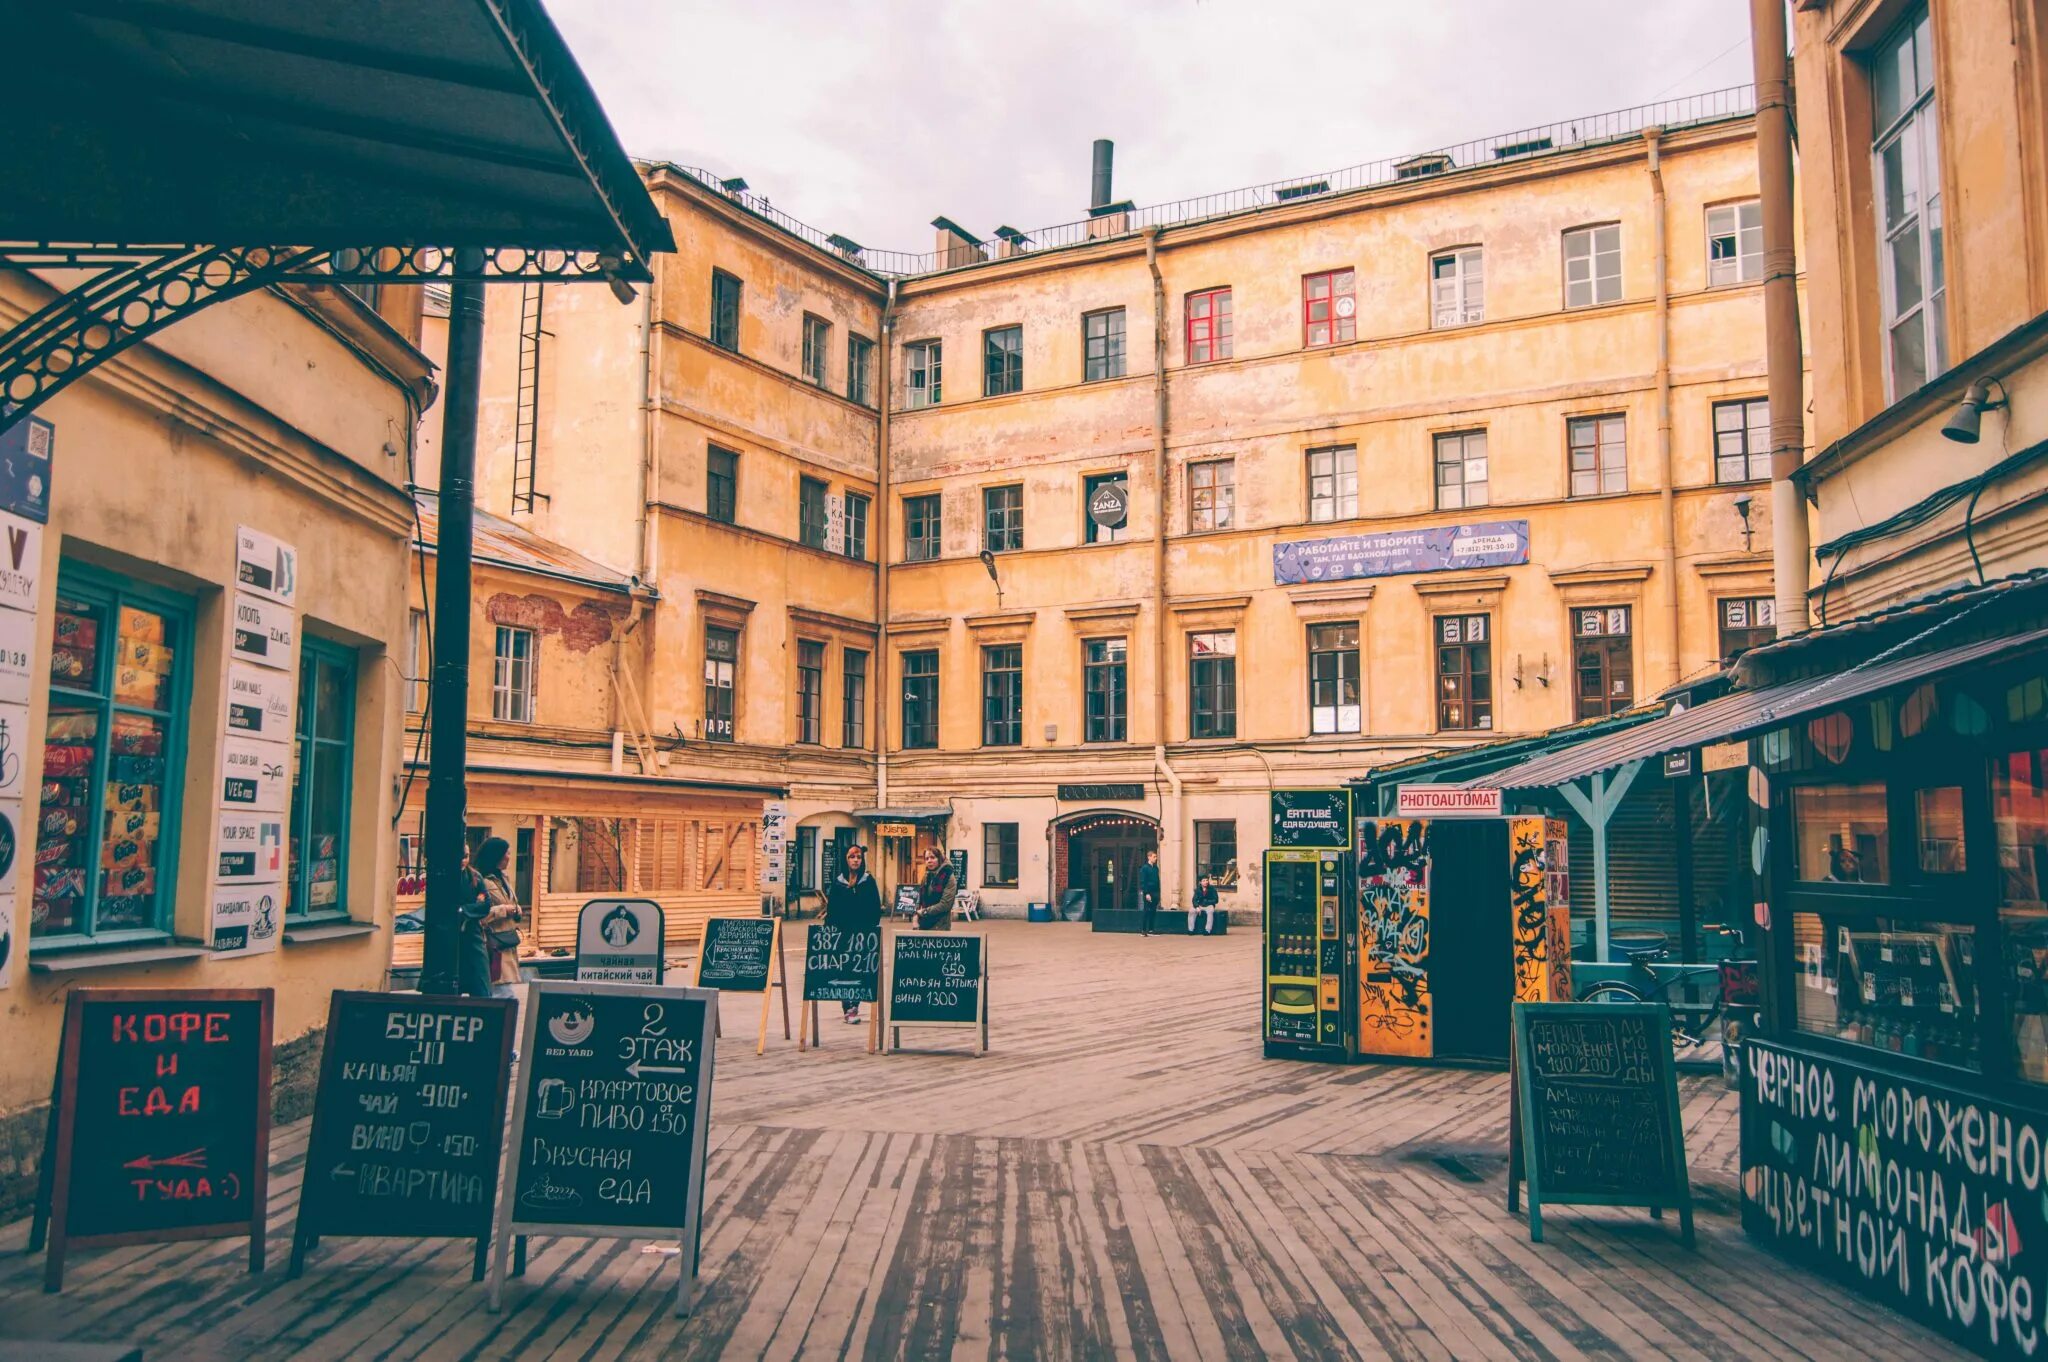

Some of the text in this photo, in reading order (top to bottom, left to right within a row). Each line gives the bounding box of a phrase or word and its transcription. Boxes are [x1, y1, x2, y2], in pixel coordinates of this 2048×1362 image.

[1092, 500, 1122, 510] ZANZA
[1298, 535, 1425, 556] РАБОТАЙТЕ И ТВОРИТЕ
[1472, 537, 1502, 545] АРЕНДА
[238, 605, 261, 624] КЛОПЪ
[228, 781, 243, 798] VEG
[1400, 793, 1498, 806] PHOTOAUTOMAT
[223, 826, 255, 839] YOUR SPACE
[1298, 821, 1338, 829] БУДУЩЕГО
[811, 932, 879, 952] 387 180
[600, 955, 635, 967] чайная
[808, 952, 880, 973] СИДР 210
[942, 962, 966, 974] 650
[581, 970, 653, 980] китайский чай
[899, 977, 941, 988] КАЛЬЯН
[895, 991, 958, 1006] ВИНА 1300
[112, 1012, 231, 1043] КОФЕ
[385, 1012, 484, 1042] БУРГЕР
[641, 1003, 668, 1036] 2
[409, 1041, 445, 1065] 210
[546, 1048, 594, 1057] RED YARD
[618, 1036, 693, 1062] ЭТАЖ
[1537, 1042, 1614, 1057] МОРОЖЕНОЕ
[156, 1053, 178, 1077] И
[342, 1062, 417, 1082] КАЛЬЯН
[1548, 1057, 1611, 1073] 100/200
[118, 1085, 200, 1116] ЕДА
[359, 1093, 399, 1114] ЧАЙ
[580, 1103, 645, 1130] ПИВО
[648, 1112, 687, 1136] 150
[351, 1124, 405, 1152] ВИНО
[131, 1178, 212, 1200] ТУДА
[359, 1163, 483, 1204] КВАРТИРА
[1813, 1132, 2012, 1271] ЛИМОНАДЫ
